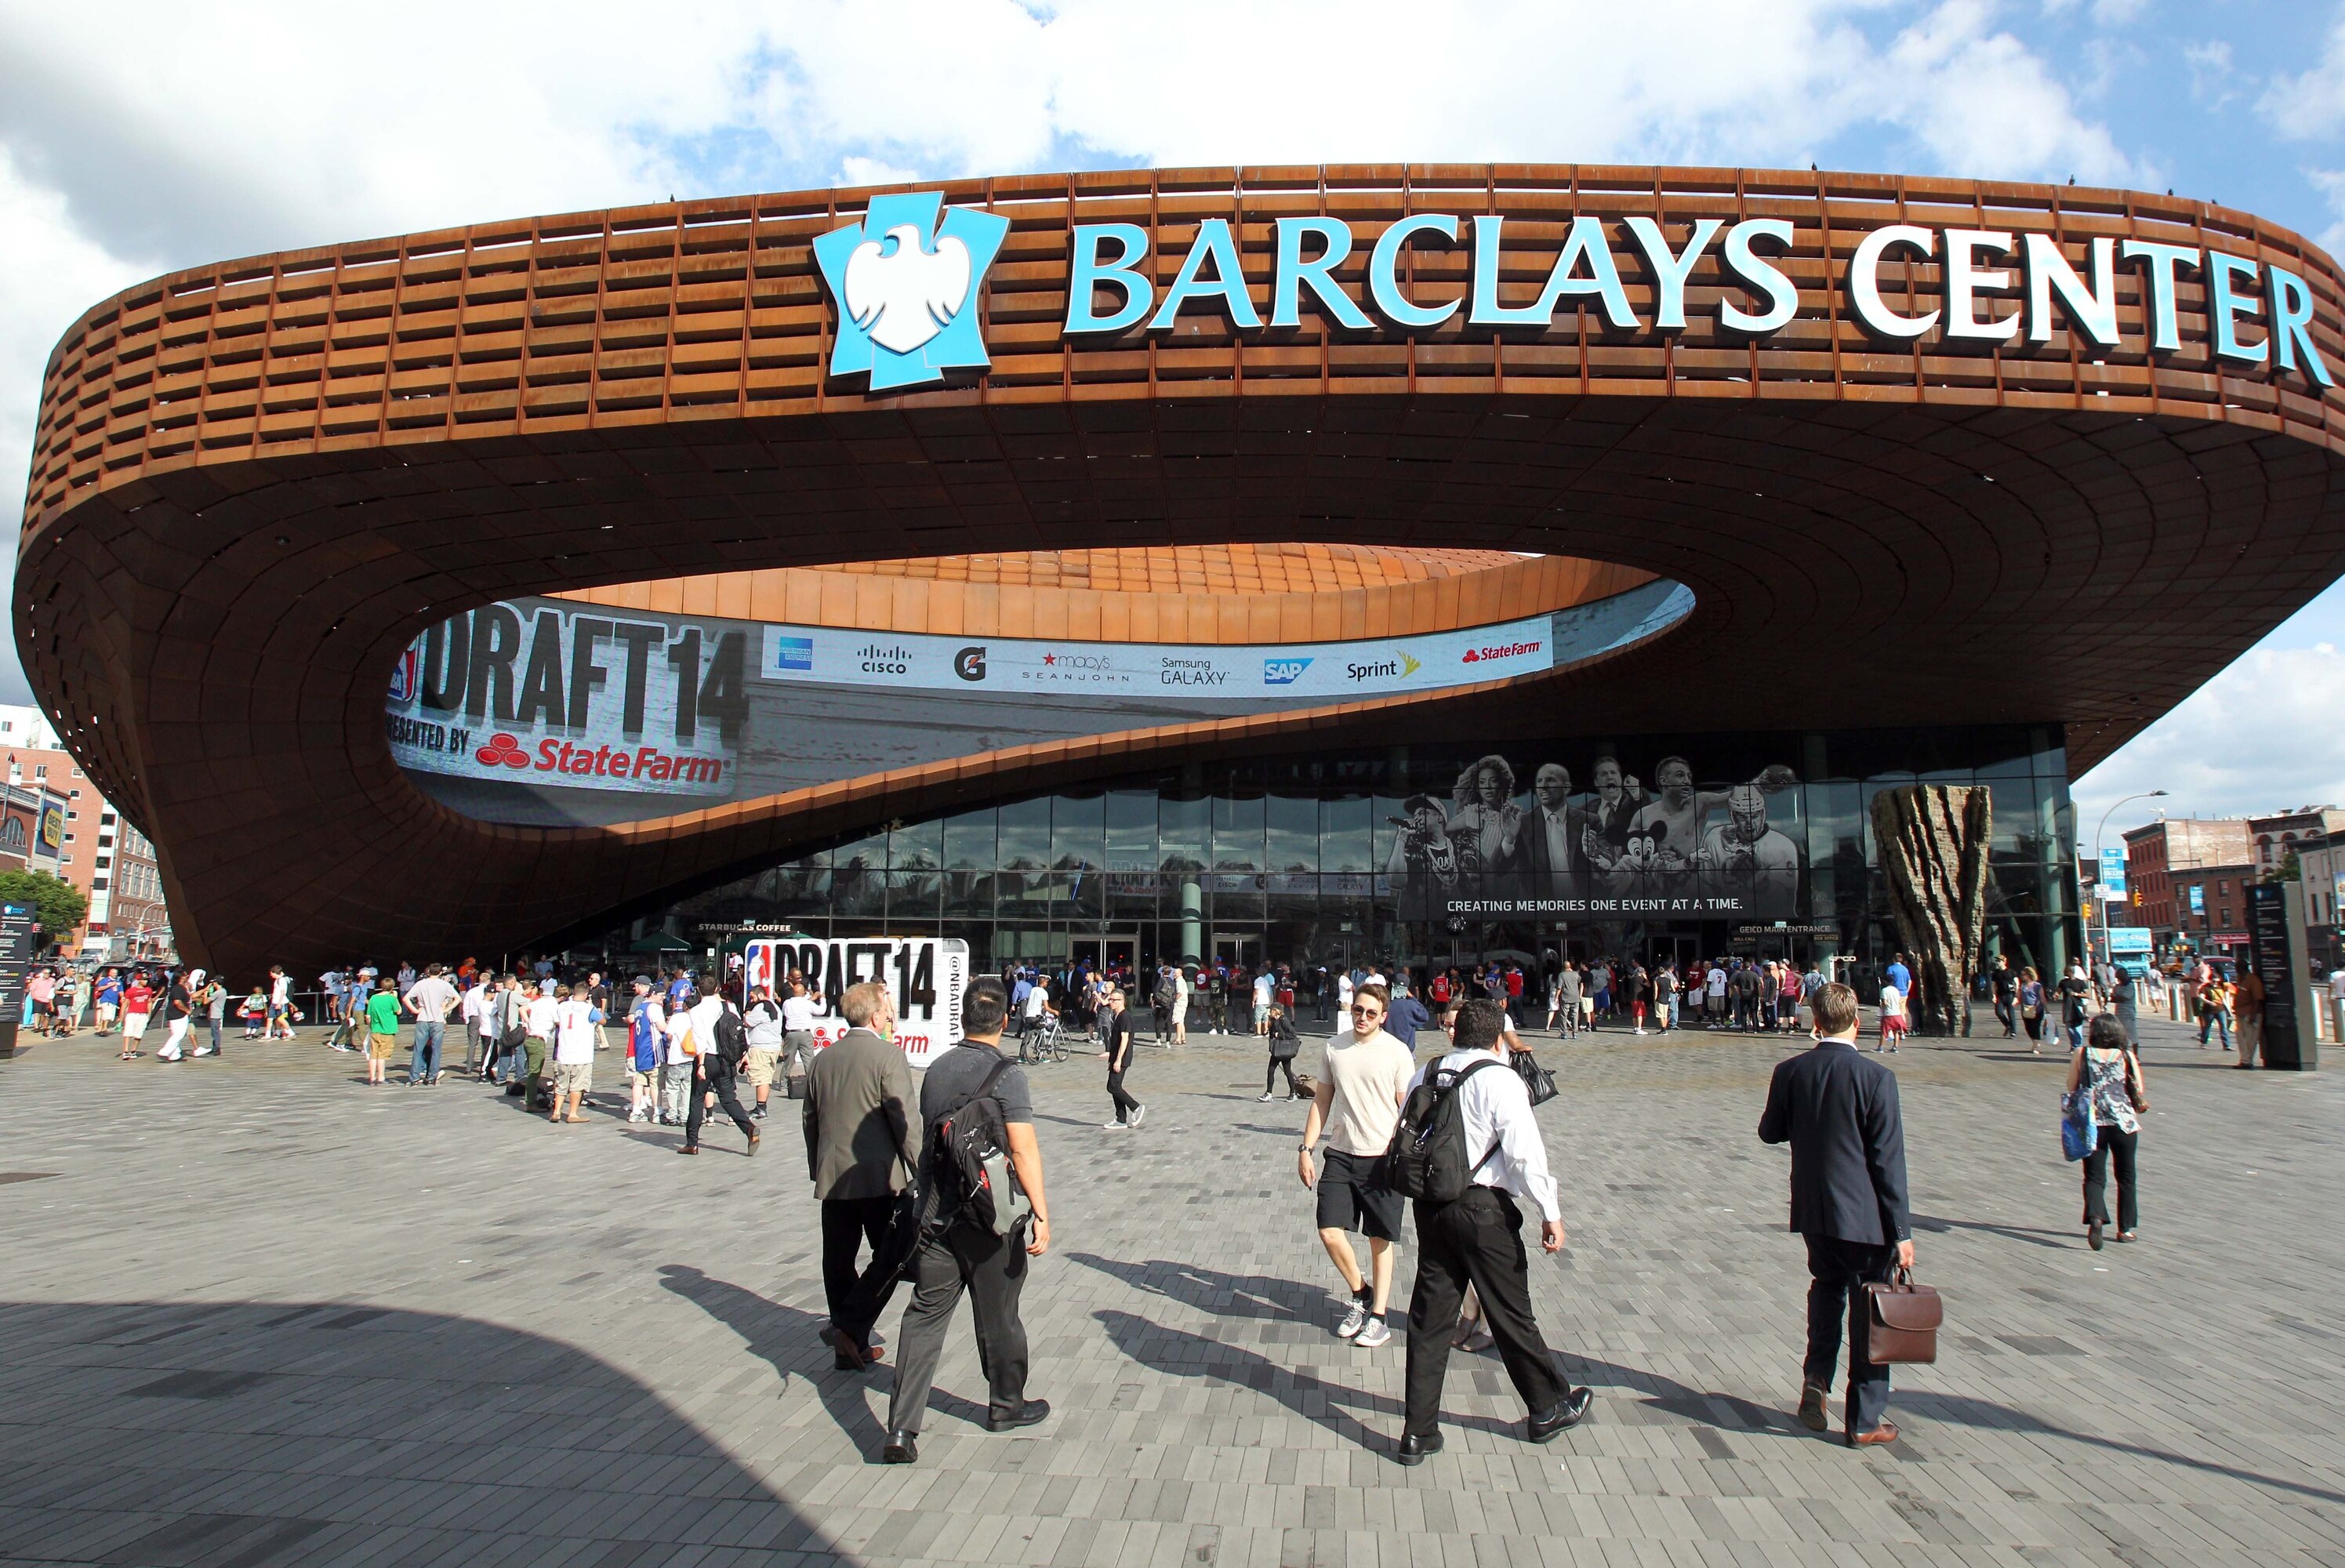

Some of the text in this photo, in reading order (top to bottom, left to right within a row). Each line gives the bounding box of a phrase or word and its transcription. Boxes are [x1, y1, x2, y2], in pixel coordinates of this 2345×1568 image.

[1064, 213, 2335, 389] BARCLAYS CENTER
[1058, 655, 1110, 672] macy's
[1162, 657, 1210, 670] Samsung
[1265, 662, 1302, 680] SAP
[1348, 659, 1397, 682] Sprint
[1162, 670, 1227, 685] GALAXY
[450, 728, 470, 756] BY
[48, 814, 61, 829] BEST
[46, 826, 59, 841] BUY
[1447, 898, 1743, 912] CREATING MEMORIES ONE EVENT AT A TIME.
[698, 923, 754, 931] STARBUCKS
[949, 956, 960, 1046] @NBADRAFT
[567, 1012, 573, 1029] 1
[894, 1034, 929, 1054] arm
